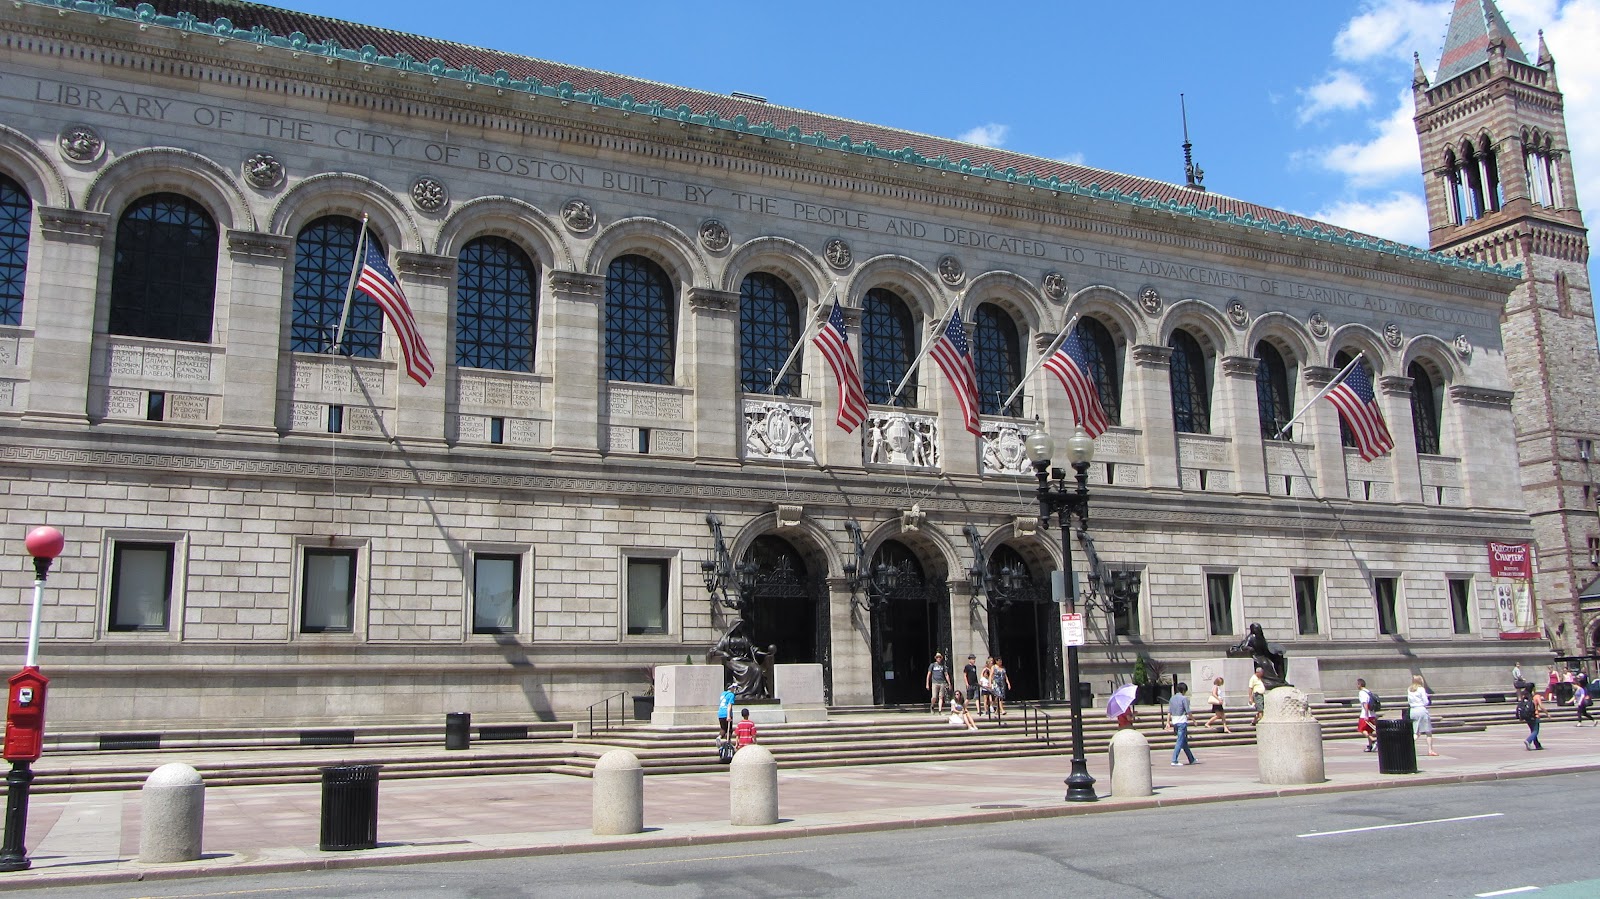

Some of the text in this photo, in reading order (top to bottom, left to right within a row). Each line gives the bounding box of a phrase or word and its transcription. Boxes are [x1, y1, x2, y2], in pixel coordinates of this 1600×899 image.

[36, 81, 172, 120] LIBRARY
[193, 107, 235, 129] OF
[260, 116, 315, 143] THE
[334, 128, 403, 155] CITY
[424, 144, 461, 164] OF
[477, 152, 586, 185] BOSTON
[602, 171, 669, 197] BUILT
[684, 185, 714, 204] BY
[731, 193, 780, 216] THE
[793, 202, 870, 230] PEOPLE
[885, 218, 927, 239] AND
[943, 227, 1046, 257] DEDICATED
[1061, 246, 1085, 264] TO
[1095, 252, 1130, 272] THE
[1138, 260, 1250, 290] ADVANCEMENT
[1260, 279, 1279, 294] OF
[1288, 283, 1357, 308] LEARNING
